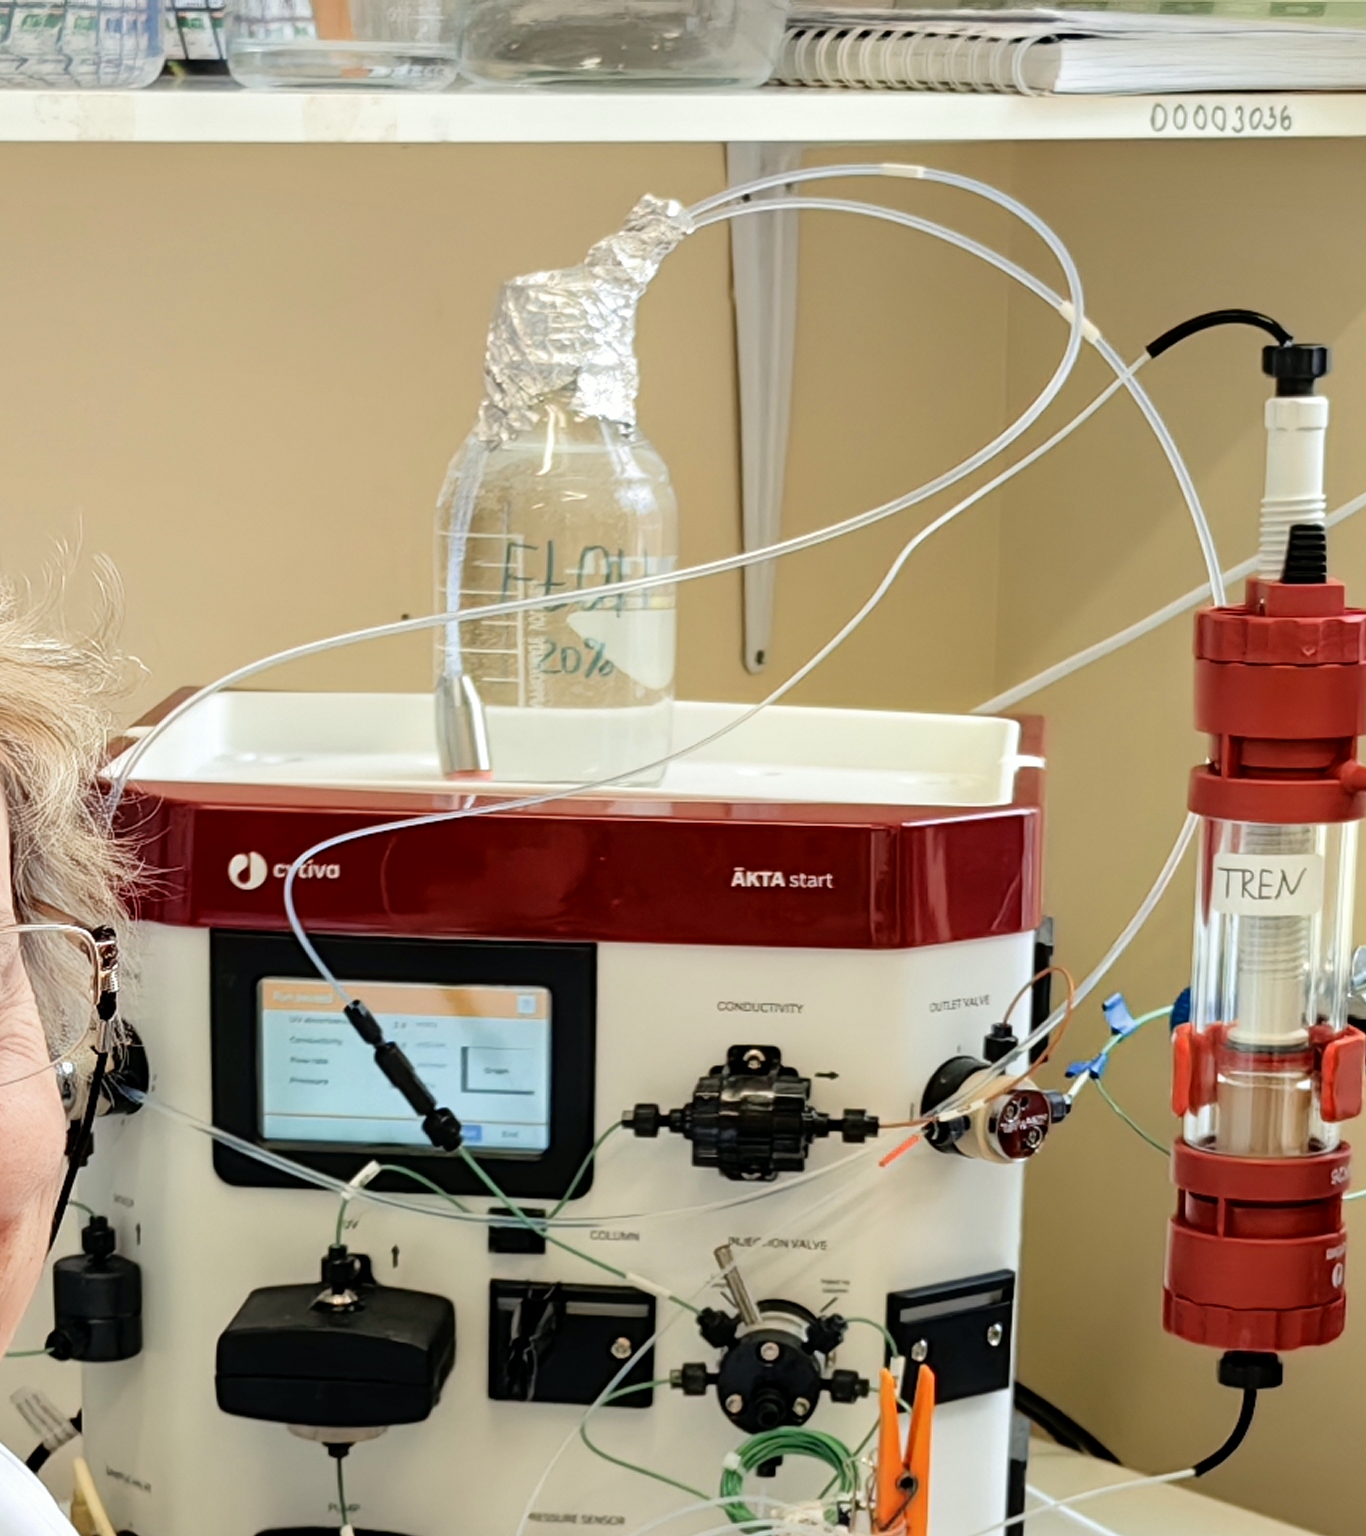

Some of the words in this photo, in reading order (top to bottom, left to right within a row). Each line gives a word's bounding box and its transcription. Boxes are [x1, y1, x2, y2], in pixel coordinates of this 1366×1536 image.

[537, 638, 614, 679] 20%
[788, 873, 834, 889] start
[1217, 866, 1308, 900] TREN
[716, 1001, 804, 1014] CONDUCTIVITY
[929, 998, 961, 1013] OUTLET
[962, 995, 991, 1008] VALVE
[589, 1230, 640, 1243] COLUMN
[792, 1239, 827, 1251] VALVE
[582, 1514, 626, 1526] SENSOR
